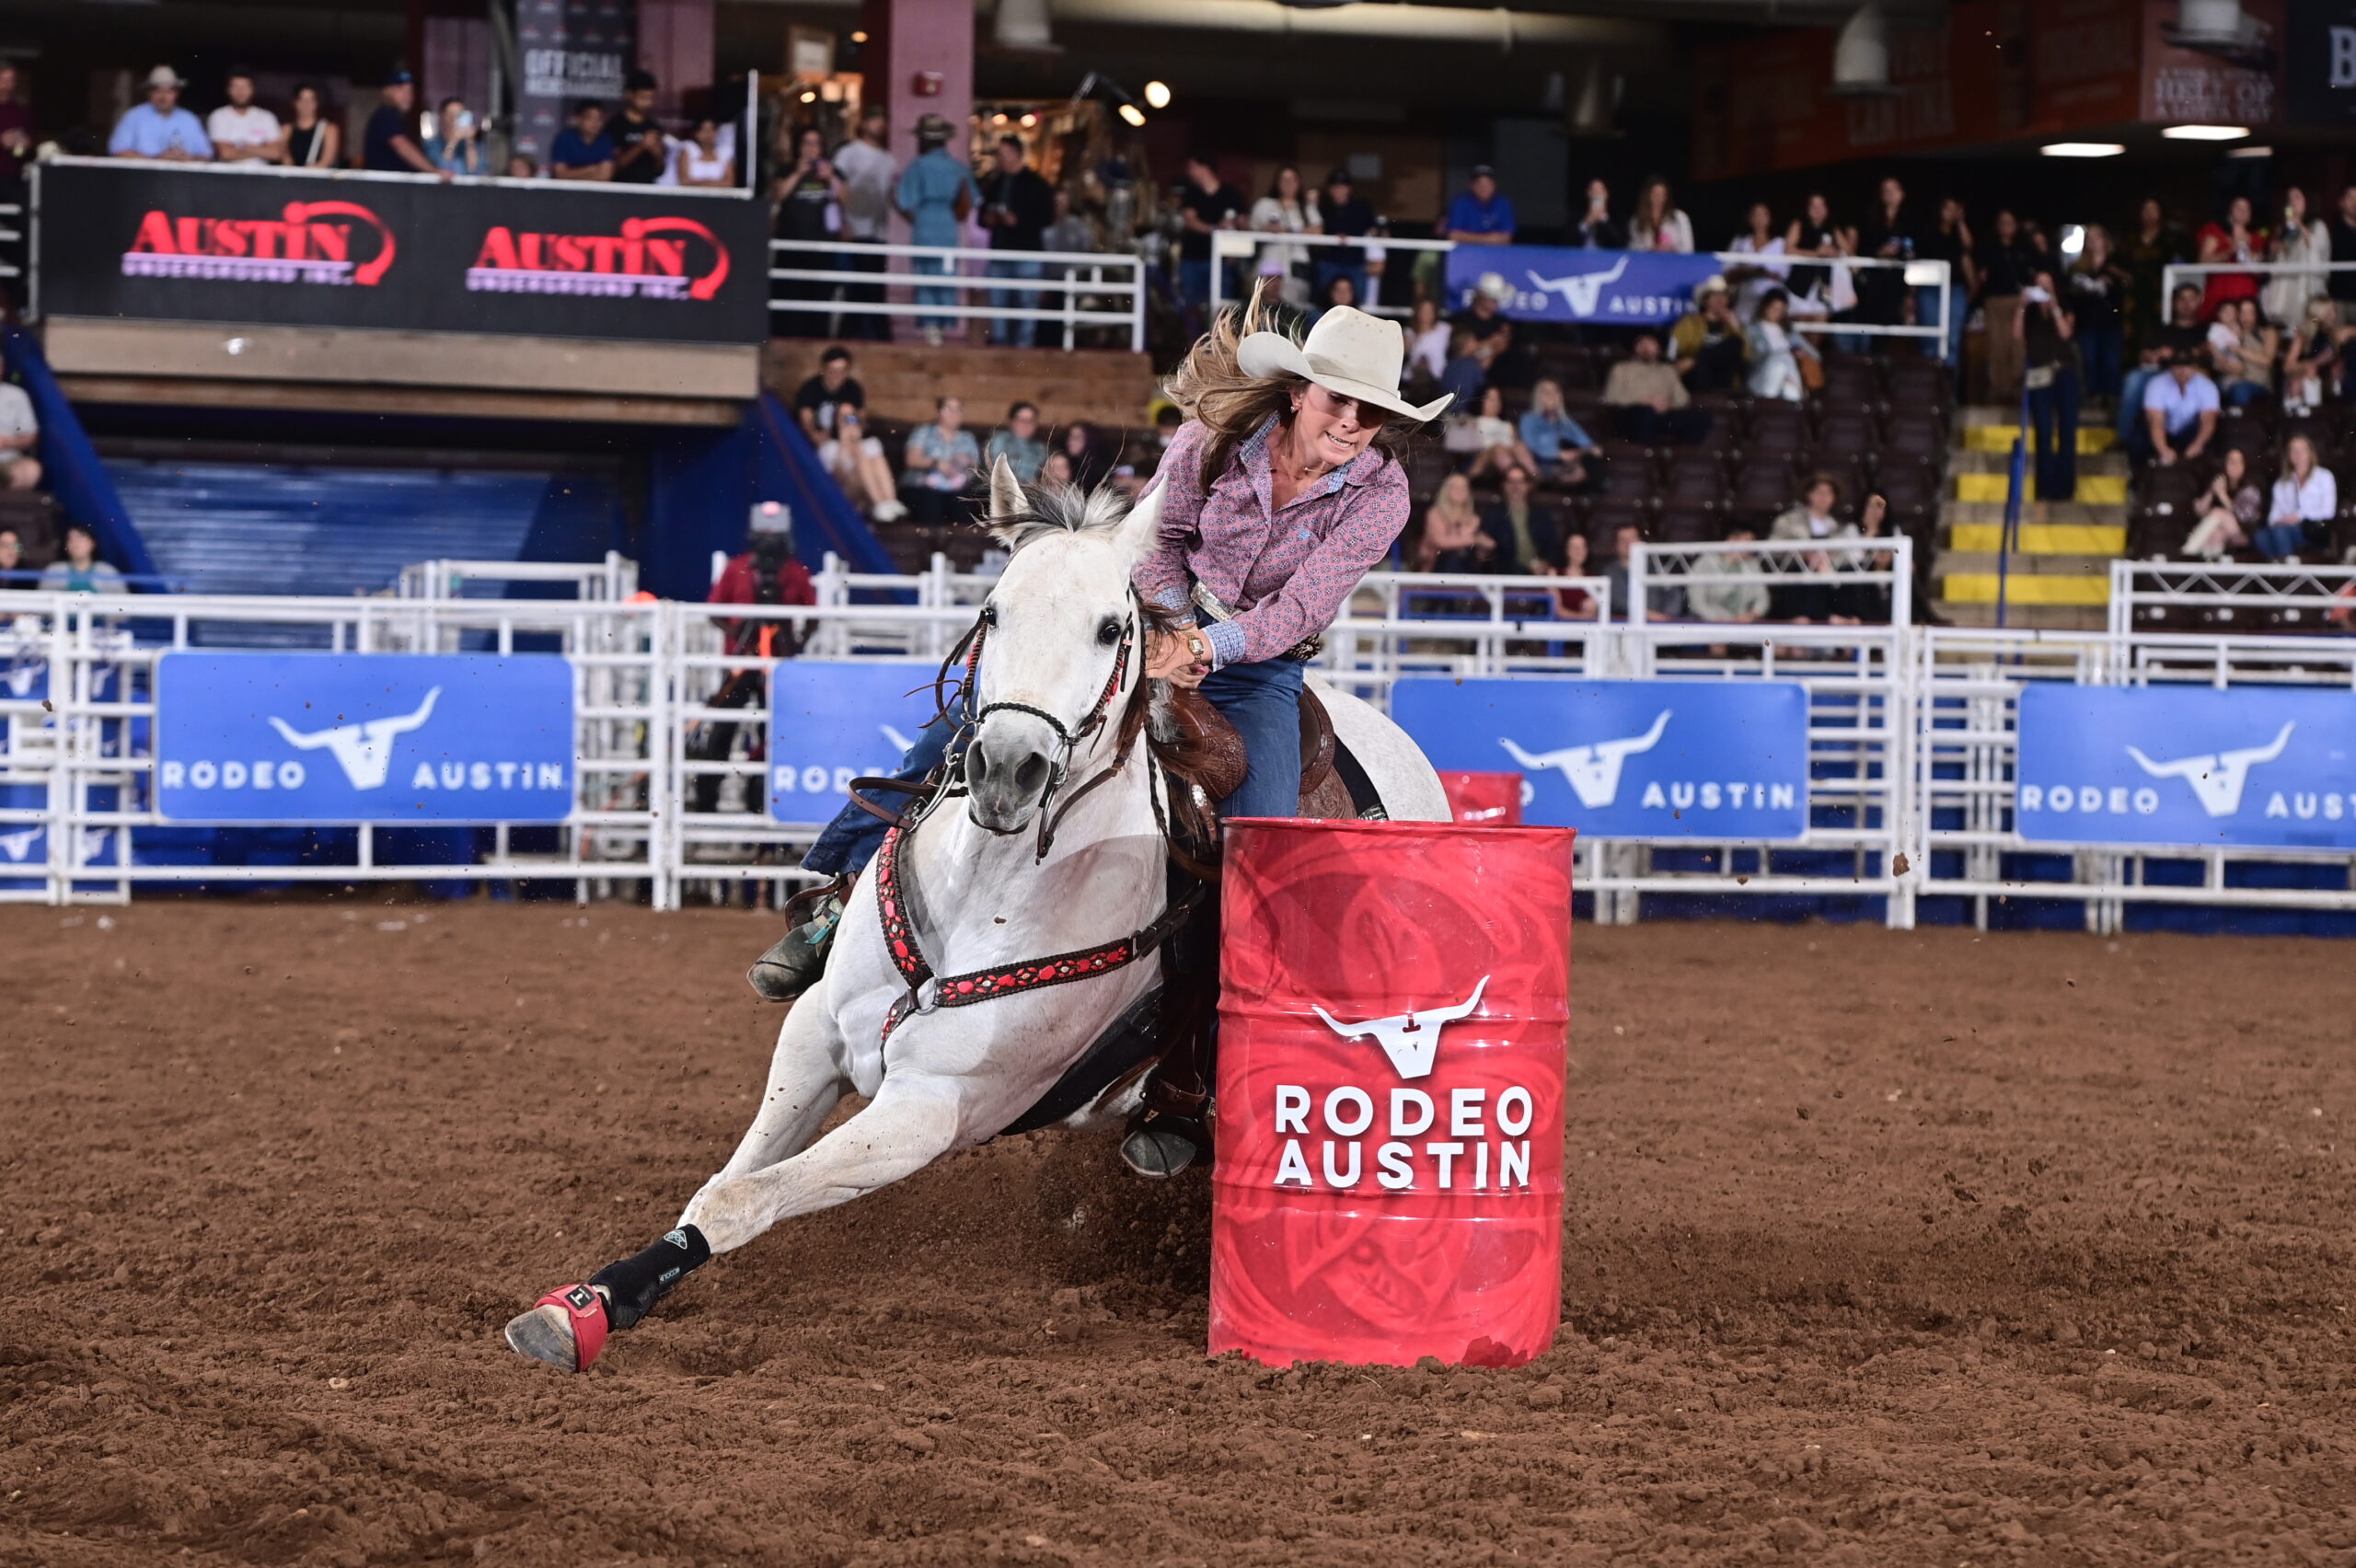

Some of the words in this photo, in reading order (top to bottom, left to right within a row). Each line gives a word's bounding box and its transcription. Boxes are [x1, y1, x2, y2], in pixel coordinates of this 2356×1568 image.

[525, 49, 622, 78] OFFICIAL
[132, 202, 352, 261] AUSTIN
[474, 217, 687, 276] AUSTIN
[1461, 288, 1548, 311] REO
[161, 760, 306, 790] RODEO
[412, 761, 563, 790] AUSTIN
[773, 766, 899, 793] ROD
[1641, 781, 1795, 810] AUSTIN
[2021, 784, 2160, 815] RODEO
[1276, 1085, 1533, 1136] RODEO
[1274, 1138, 1530, 1190] AUSTIN
